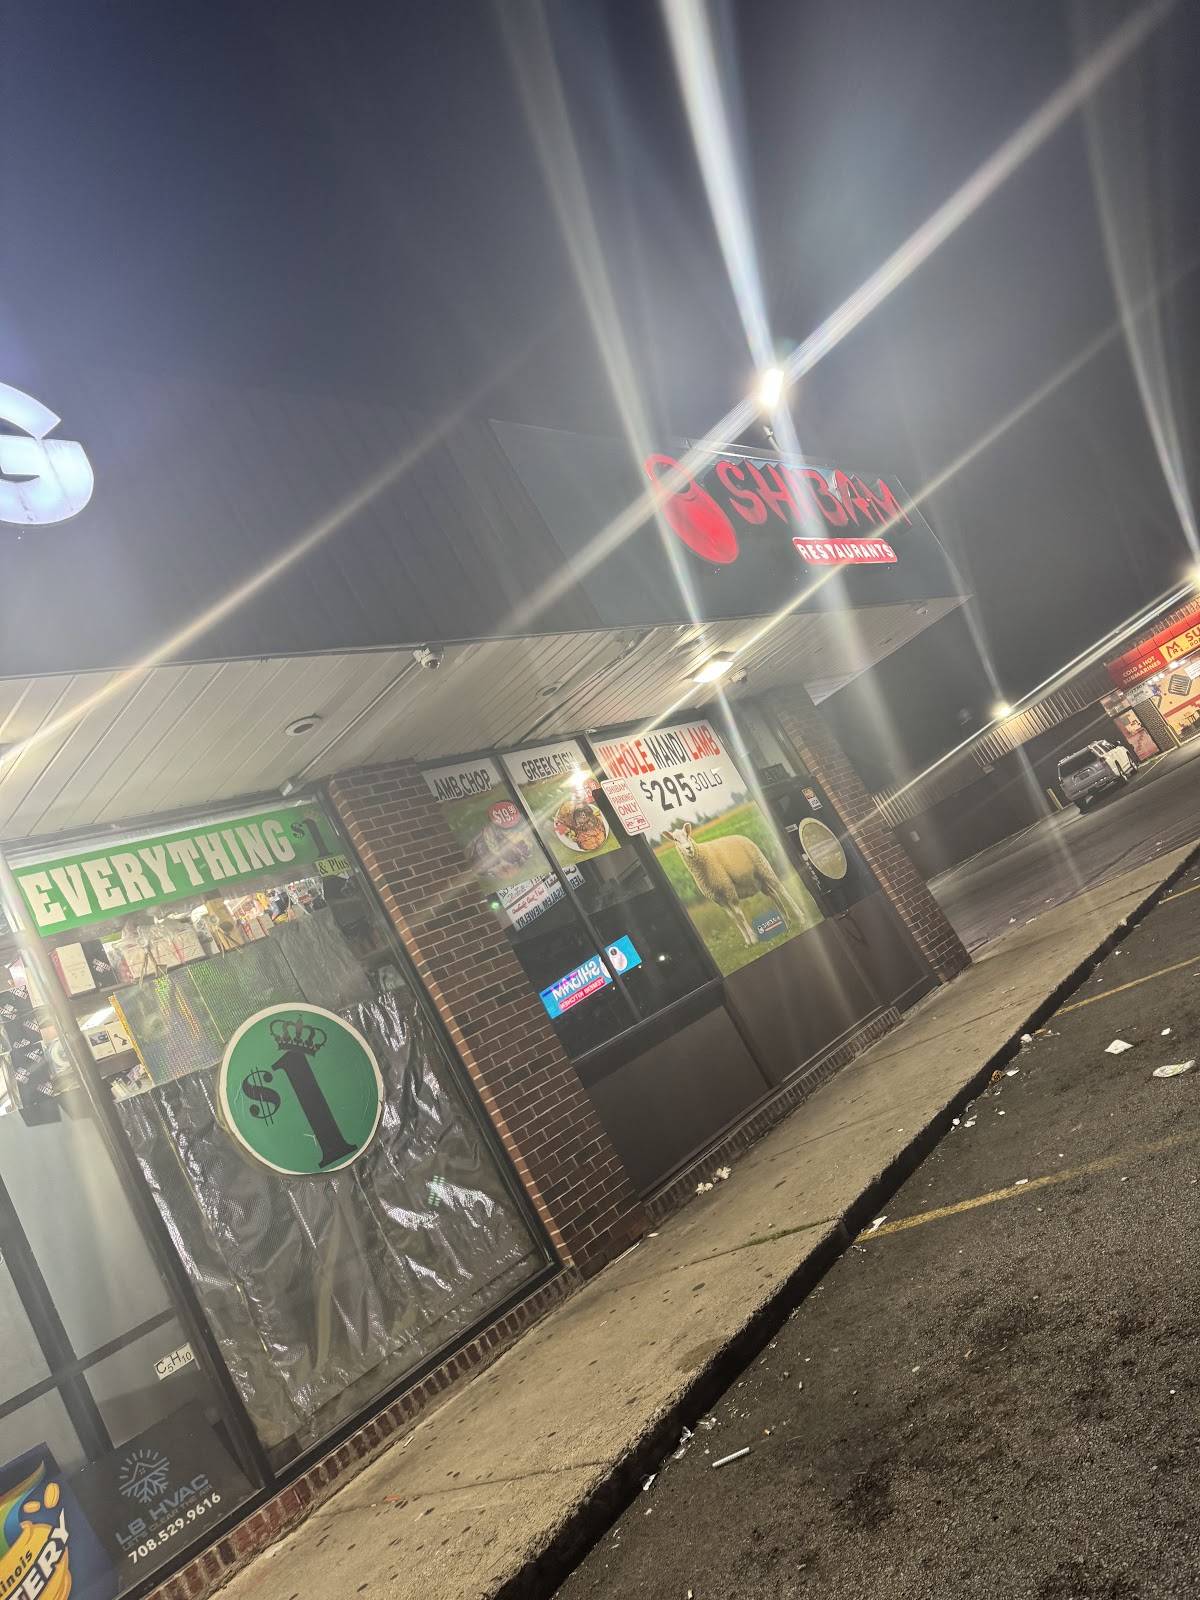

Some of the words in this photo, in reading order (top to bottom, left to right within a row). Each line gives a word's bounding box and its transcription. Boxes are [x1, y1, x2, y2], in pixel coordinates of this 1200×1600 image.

[797, 543, 893, 561] RESTAURANTS
[1123, 666, 1138, 678] COLD
[1142, 656, 1155, 666] HOT
[521, 756, 557, 780] GREEK
[598, 739, 656, 779] WHOLE
[643, 731, 692, 770] MANDI
[679, 724, 721, 760] LAMB
[433, 775, 464, 801] AMB
[459, 768, 491, 795] CHOP
[639, 772, 697, 812] $295
[618, 802, 638, 816] ONLY
[18, 819, 296, 927] EVERYTHING
[318, 861, 329, 875] &
[327, 857, 350, 872] Plus
[115, 1517, 146, 1545] LB
[148, 1473, 209, 1521] HVAC
[128, 1492, 221, 1564] 708.529.9616
[0, 1550, 33, 1598] inois
